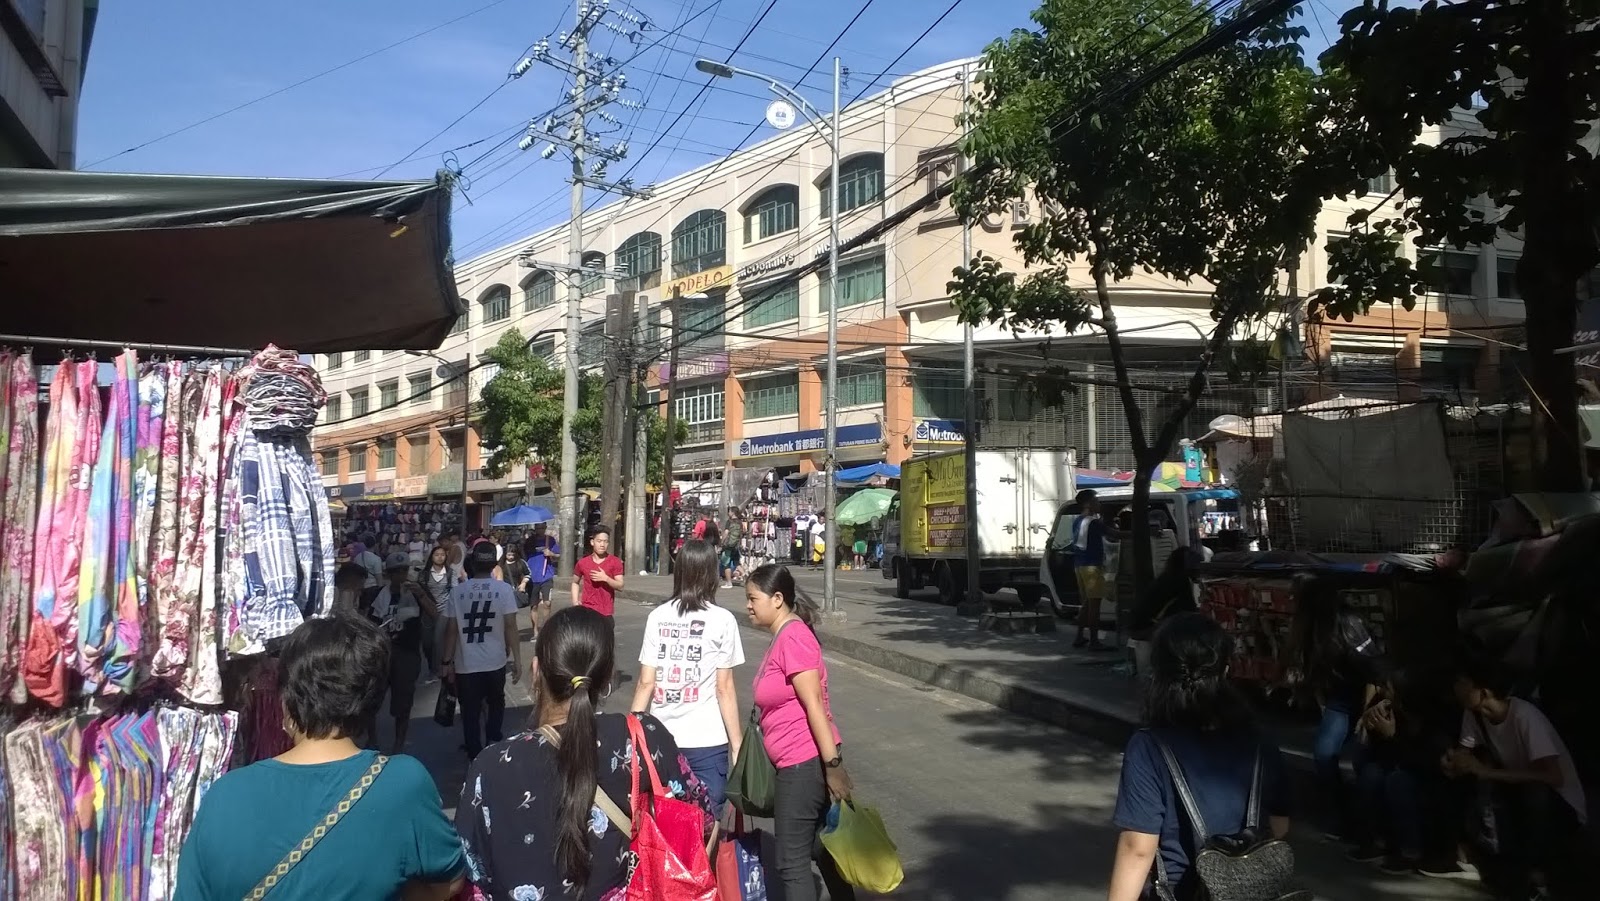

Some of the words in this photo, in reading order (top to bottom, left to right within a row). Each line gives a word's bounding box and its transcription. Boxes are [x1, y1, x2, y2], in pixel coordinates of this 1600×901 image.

[737, 252, 796, 280] McDonald's
[665, 270, 723, 299] MODELO
[751, 440, 794, 455] Metrobank
[460, 591, 500, 599] HONOR
[462, 601, 496, 643] #
